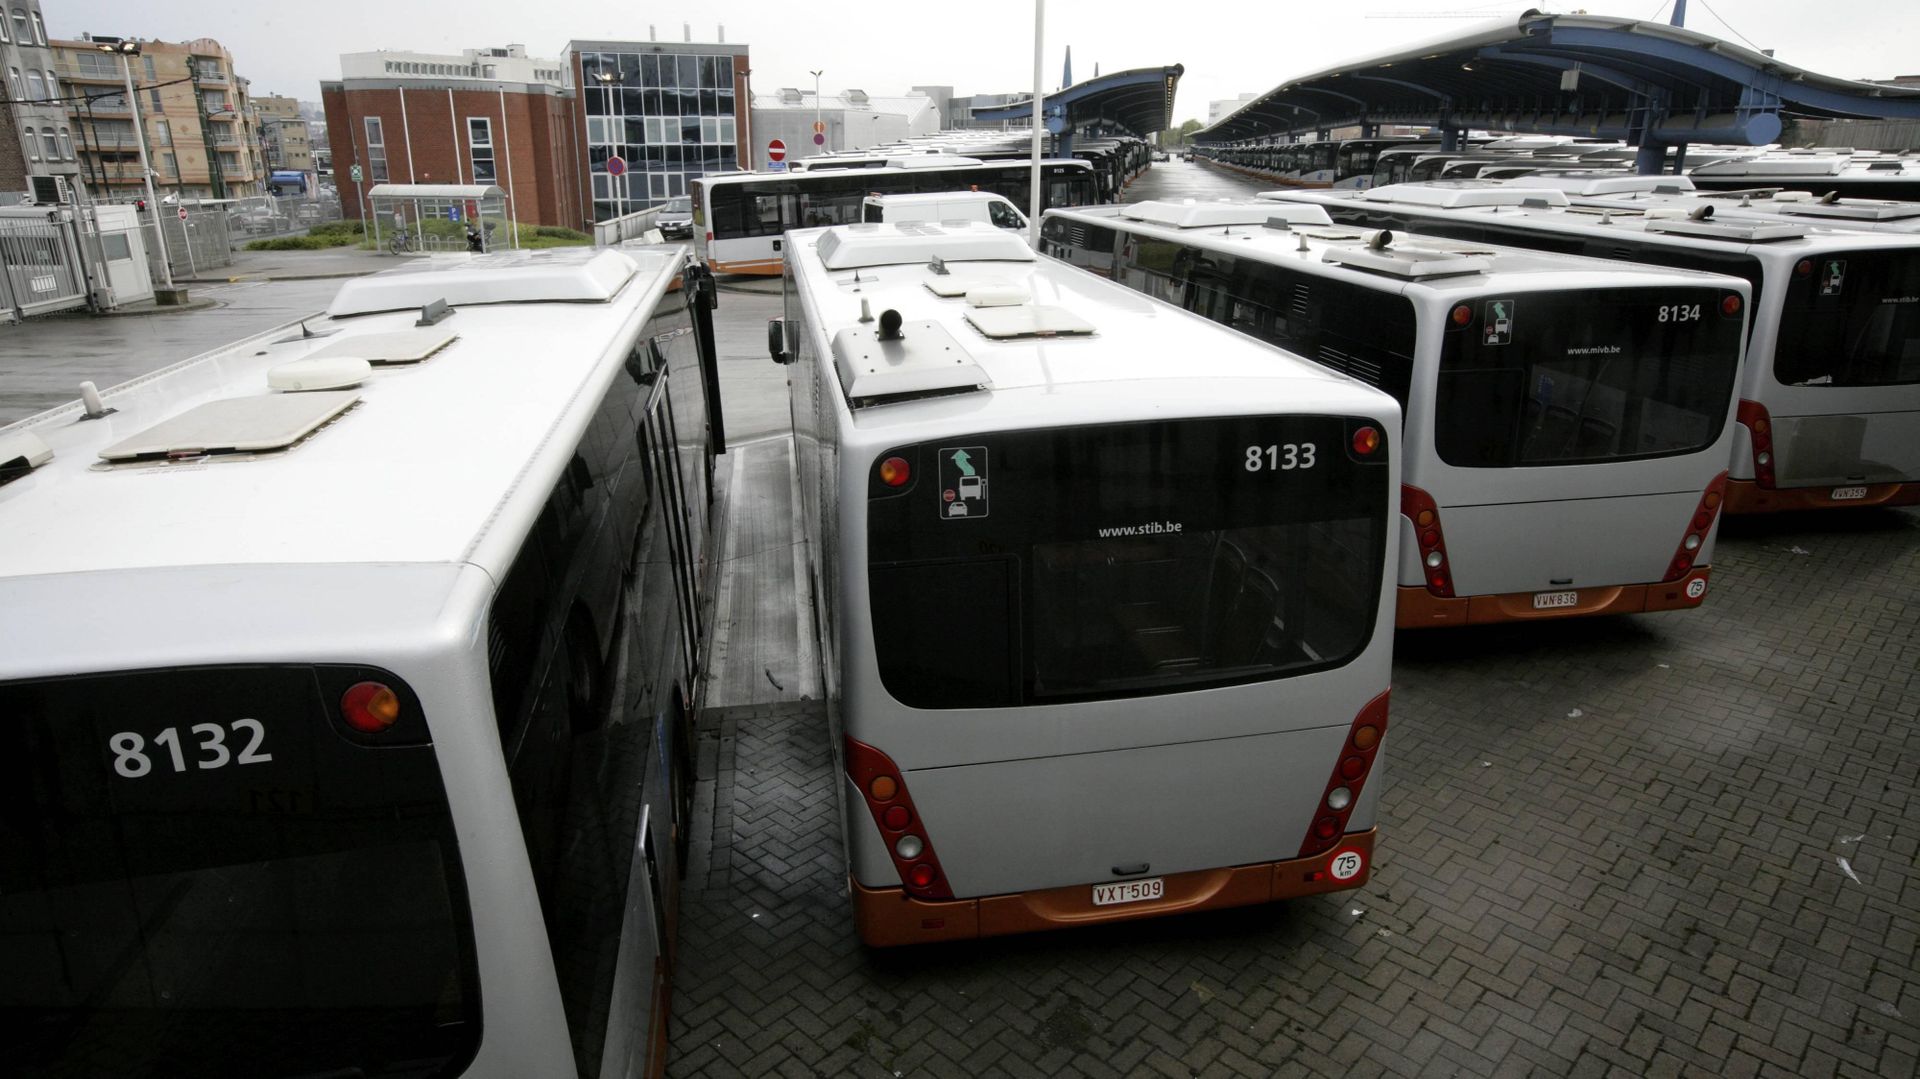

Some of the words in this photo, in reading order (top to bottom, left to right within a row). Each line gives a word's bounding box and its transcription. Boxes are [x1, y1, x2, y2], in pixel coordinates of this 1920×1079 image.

[1658, 304, 1701, 323] 8134
[1567, 345, 1621, 355] www.mivb.be
[1245, 442, 1317, 472] 8133
[1099, 521, 1183, 538] www.stib.be
[1691, 581, 1703, 592] 75
[109, 718, 273, 778] 8132
[1337, 855, 1356, 871] 75
